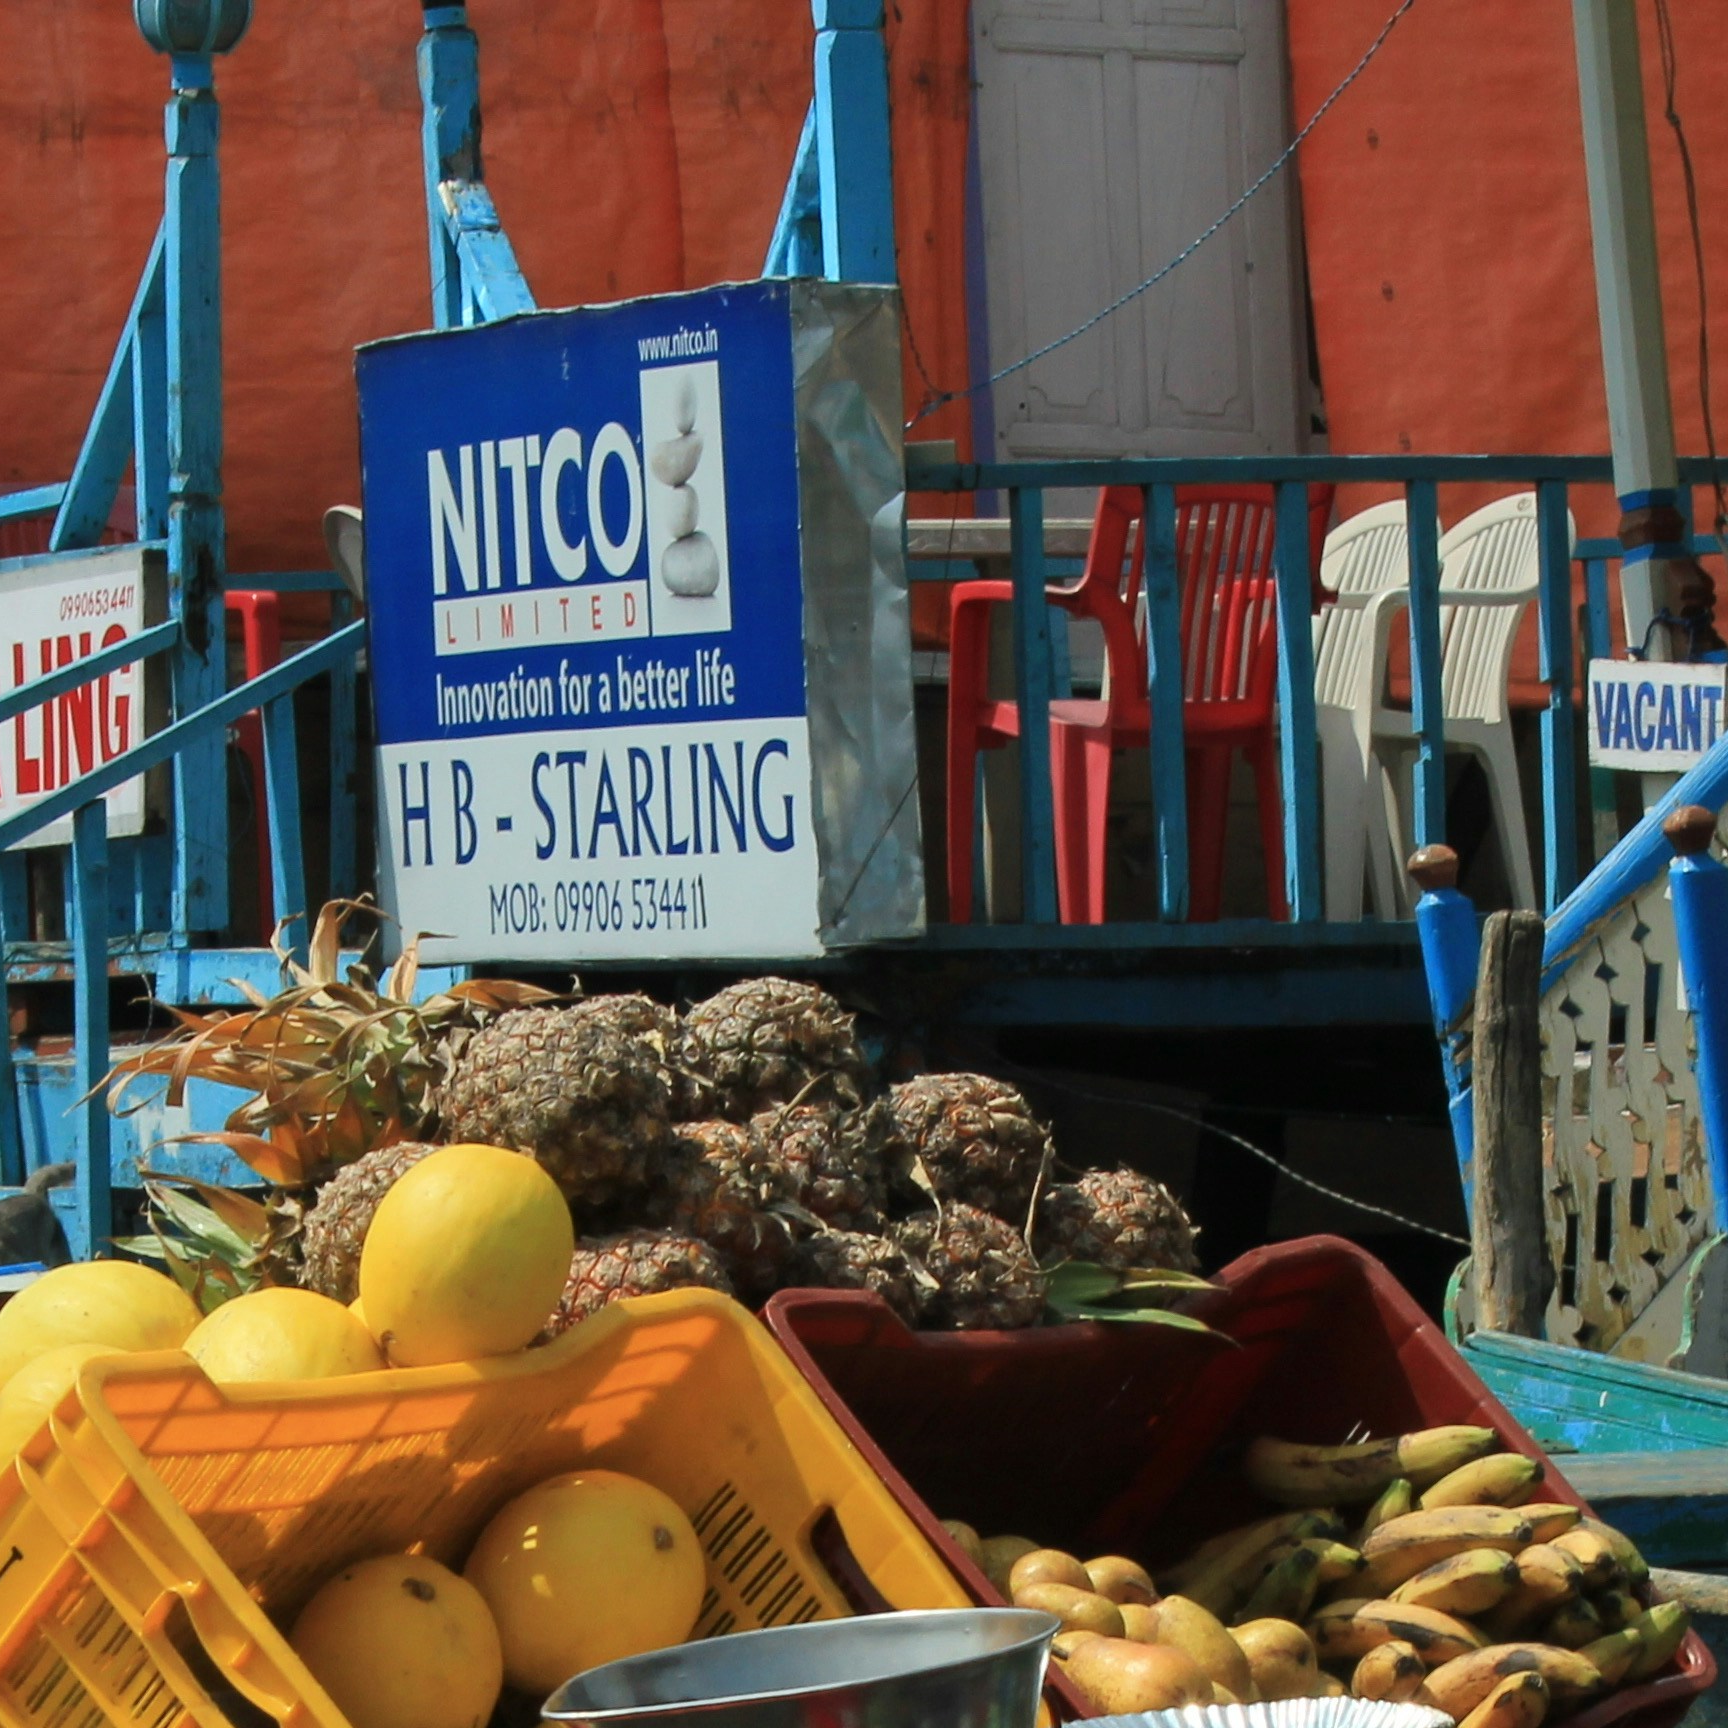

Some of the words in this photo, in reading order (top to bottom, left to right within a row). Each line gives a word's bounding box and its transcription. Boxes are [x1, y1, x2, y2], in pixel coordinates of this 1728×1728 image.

[637, 322, 719, 362] www.nitco.in
[427, 421, 645, 597] NITCO
[445, 592, 636, 644] LIMITED
[435, 664, 554, 726] Innovation
[558, 658, 592, 716] for
[598, 672, 612, 713] a
[616, 654, 689, 712] better
[695, 647, 736, 708] life
[1593, 681, 1723, 752] VACANT
[531, 738, 795, 861] STARLING
[489, 881, 547, 935] MOB:
[553, 879, 623, 933] 09906
[632, 872, 707, 930] 534411
